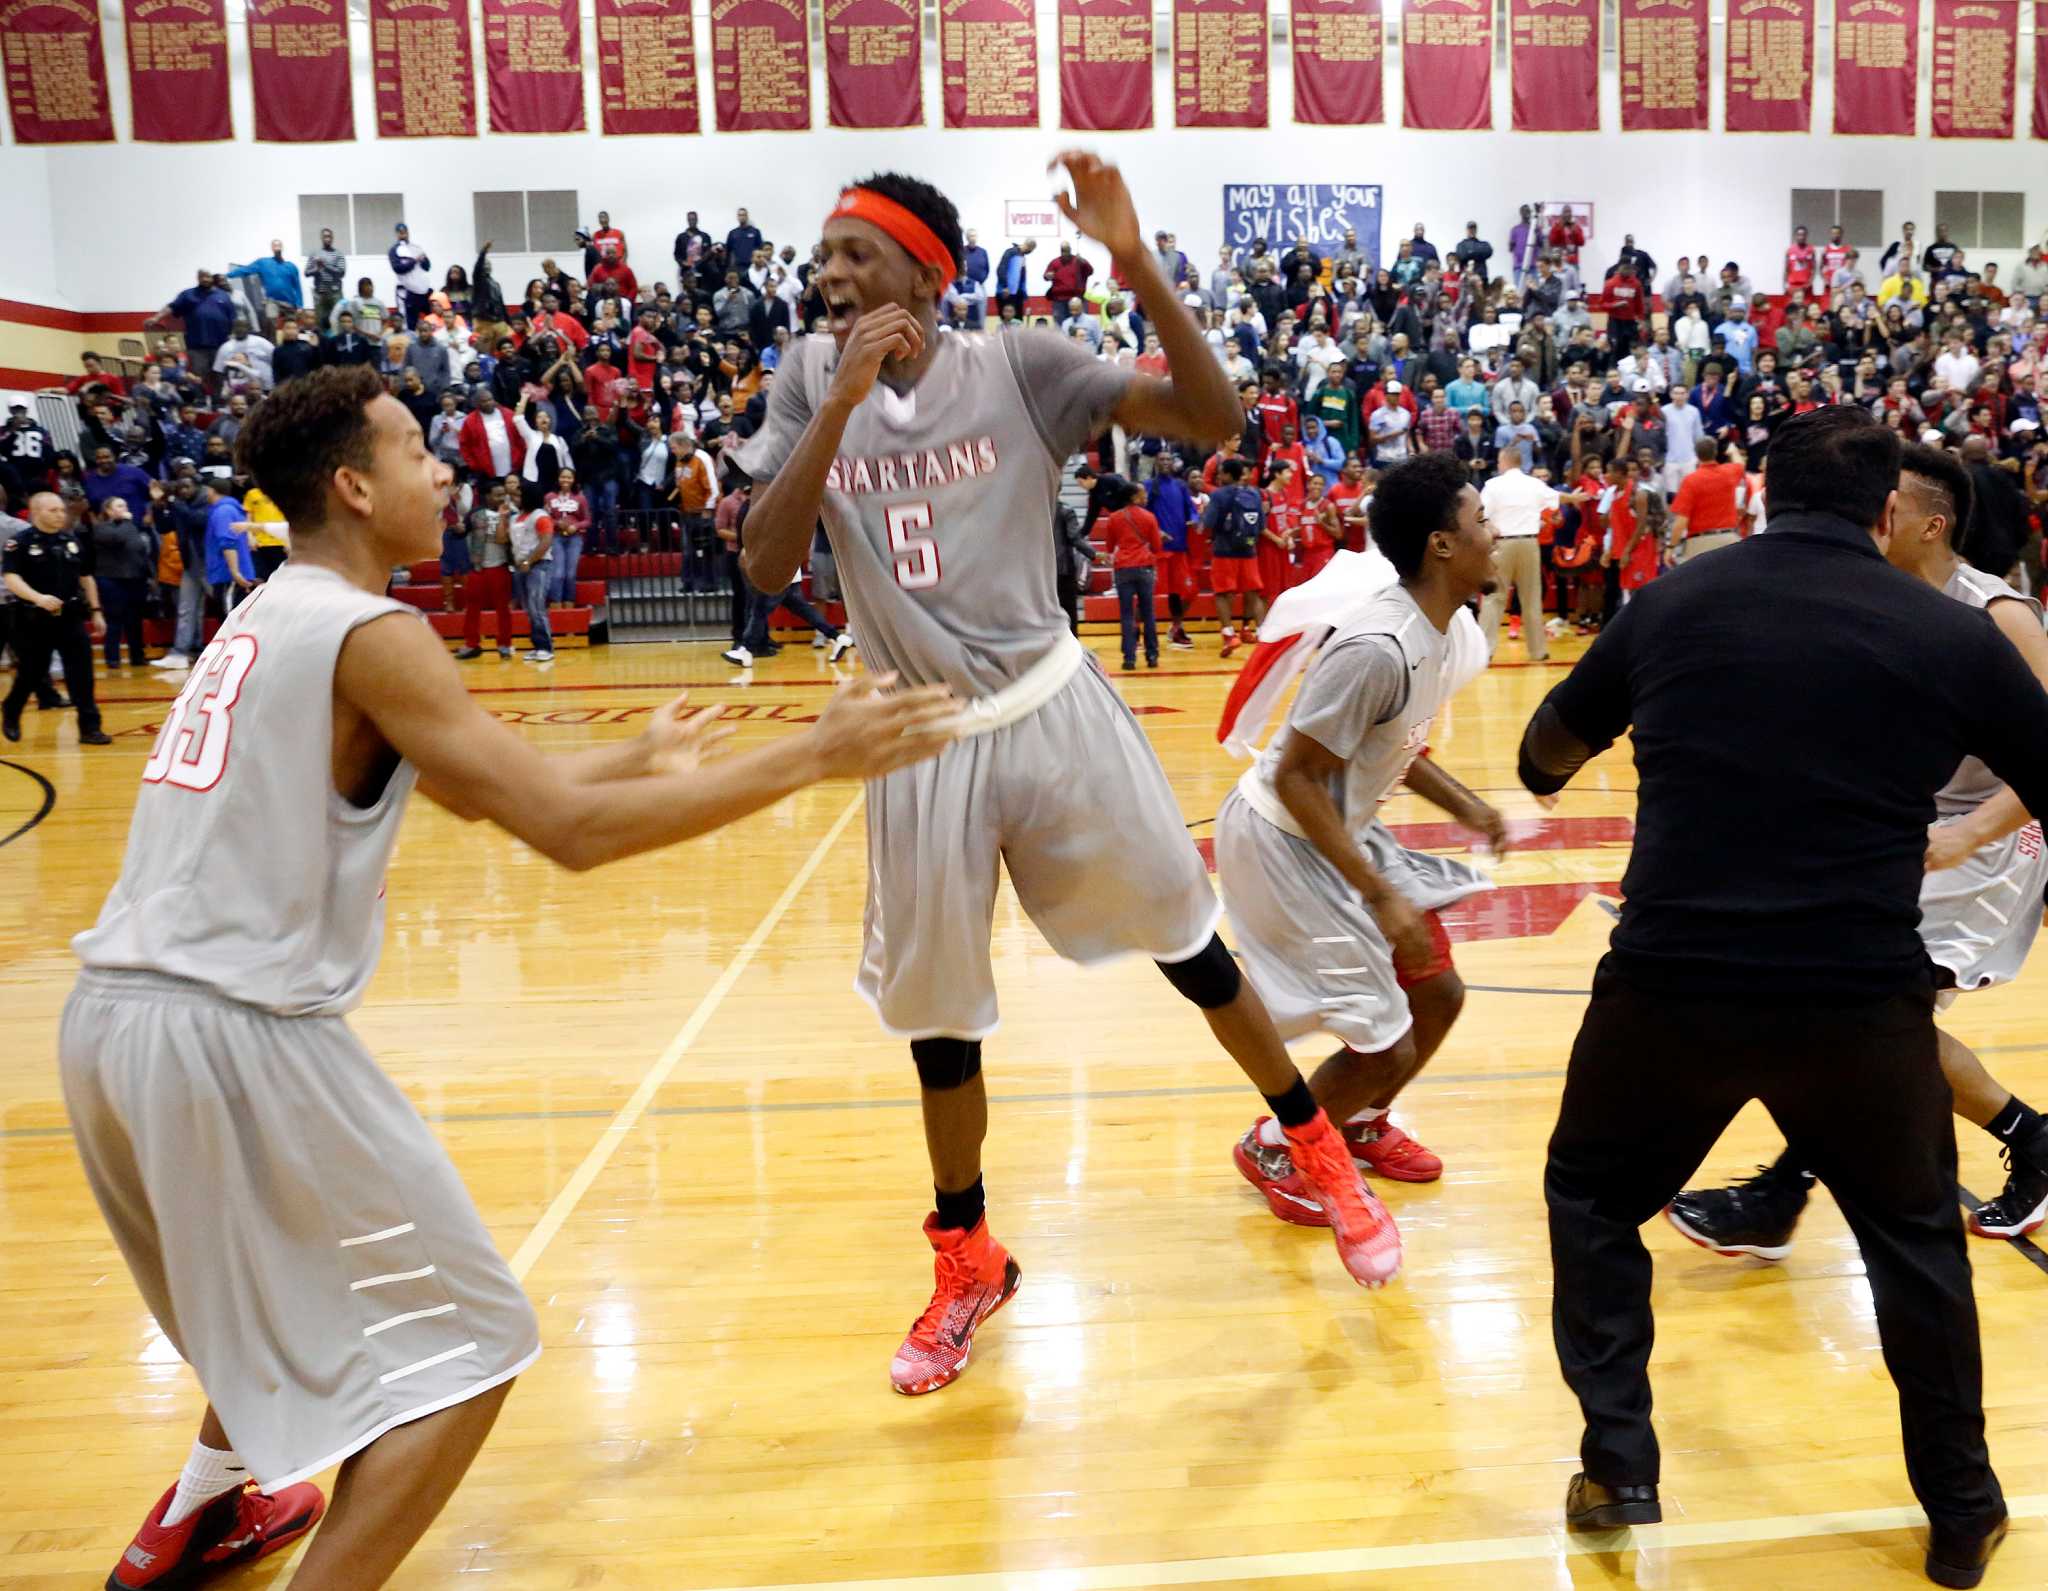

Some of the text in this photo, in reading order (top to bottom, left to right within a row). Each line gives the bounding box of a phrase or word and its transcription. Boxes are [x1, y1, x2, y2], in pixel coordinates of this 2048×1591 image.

[1229, 185, 1379, 211] May all your
[11, 430, 44, 459] 36
[885, 501, 942, 592] 5
[124, 1544, 158, 1570] NIKE
